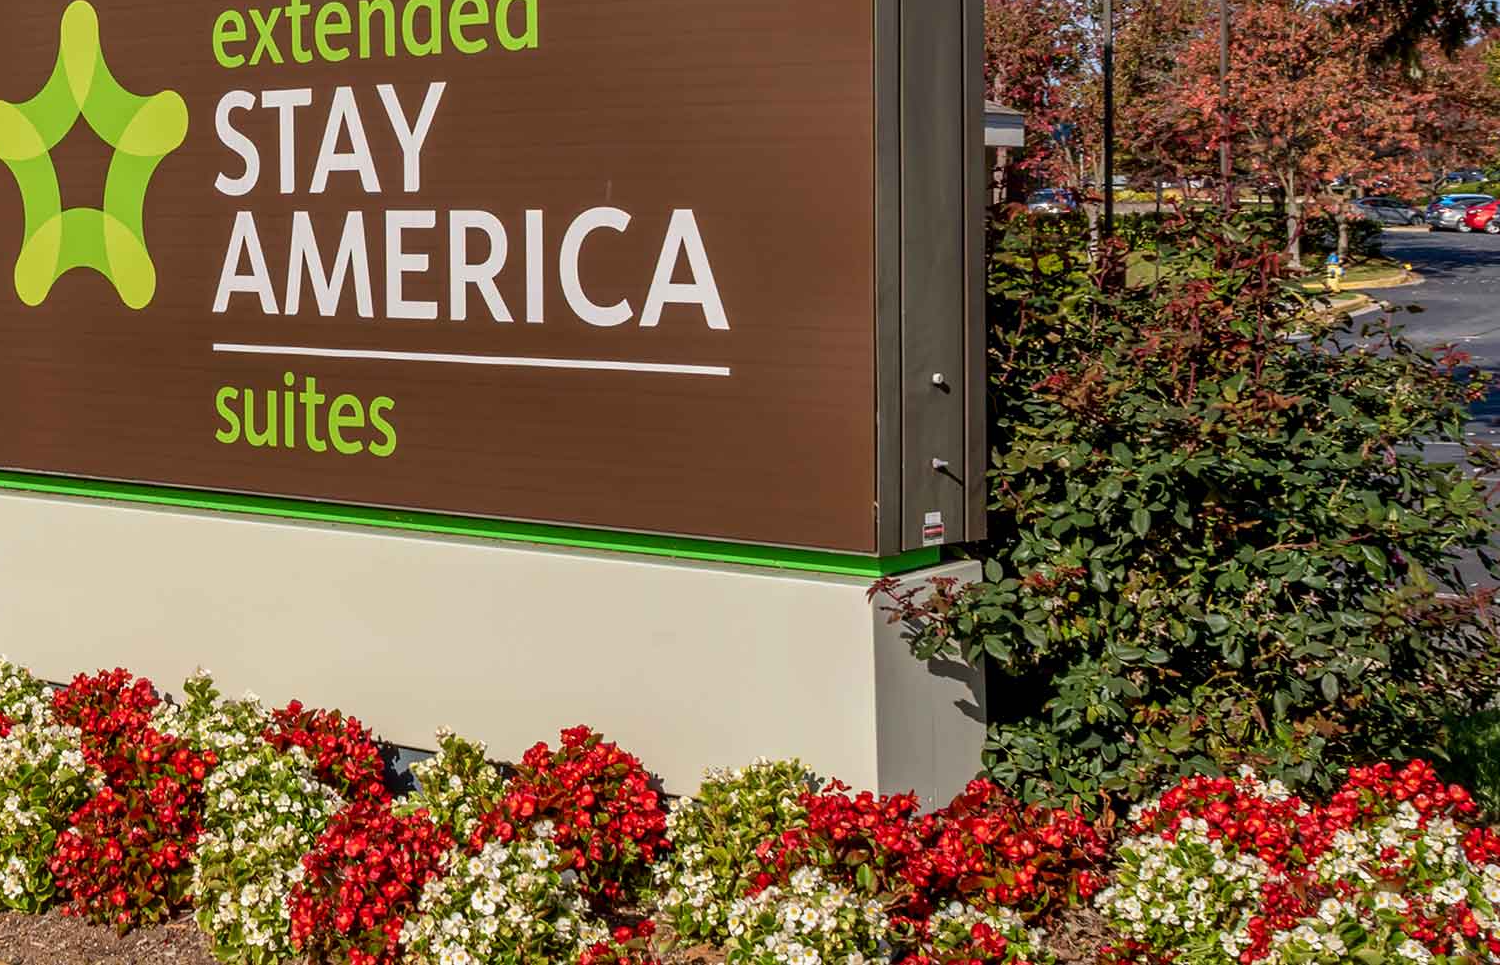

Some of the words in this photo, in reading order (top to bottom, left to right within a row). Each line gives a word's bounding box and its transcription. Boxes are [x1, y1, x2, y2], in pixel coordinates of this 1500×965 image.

[213, 81, 447, 197] STAY
[212, 207, 731, 331] AMERICA
[215, 371, 397, 457] suites
